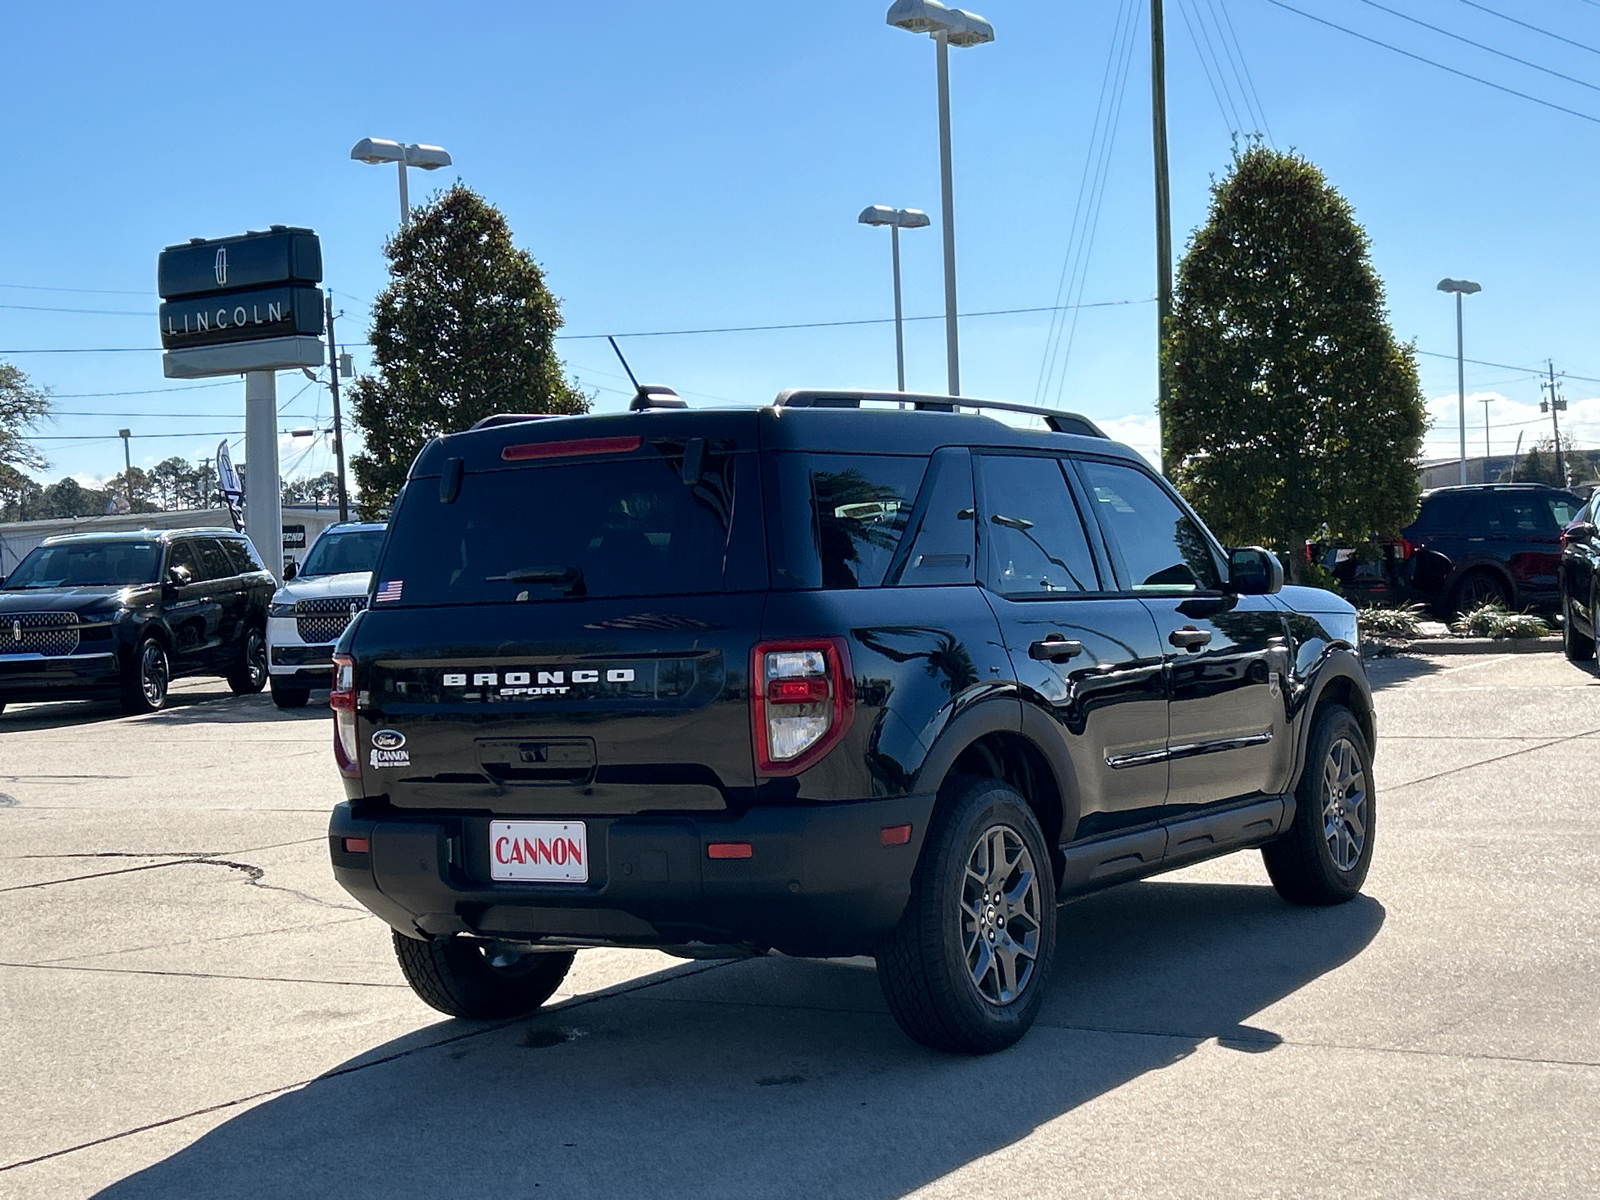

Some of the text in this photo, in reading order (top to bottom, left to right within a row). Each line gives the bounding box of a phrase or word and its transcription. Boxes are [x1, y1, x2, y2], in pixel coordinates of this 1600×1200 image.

[168, 301, 282, 335] LINCOLN
[443, 669, 635, 686] BRONCO
[500, 686, 570, 696] SPORT
[377, 734, 397, 746] Ford
[378, 750, 410, 761] CANNON
[495, 836, 582, 866] CANNON
